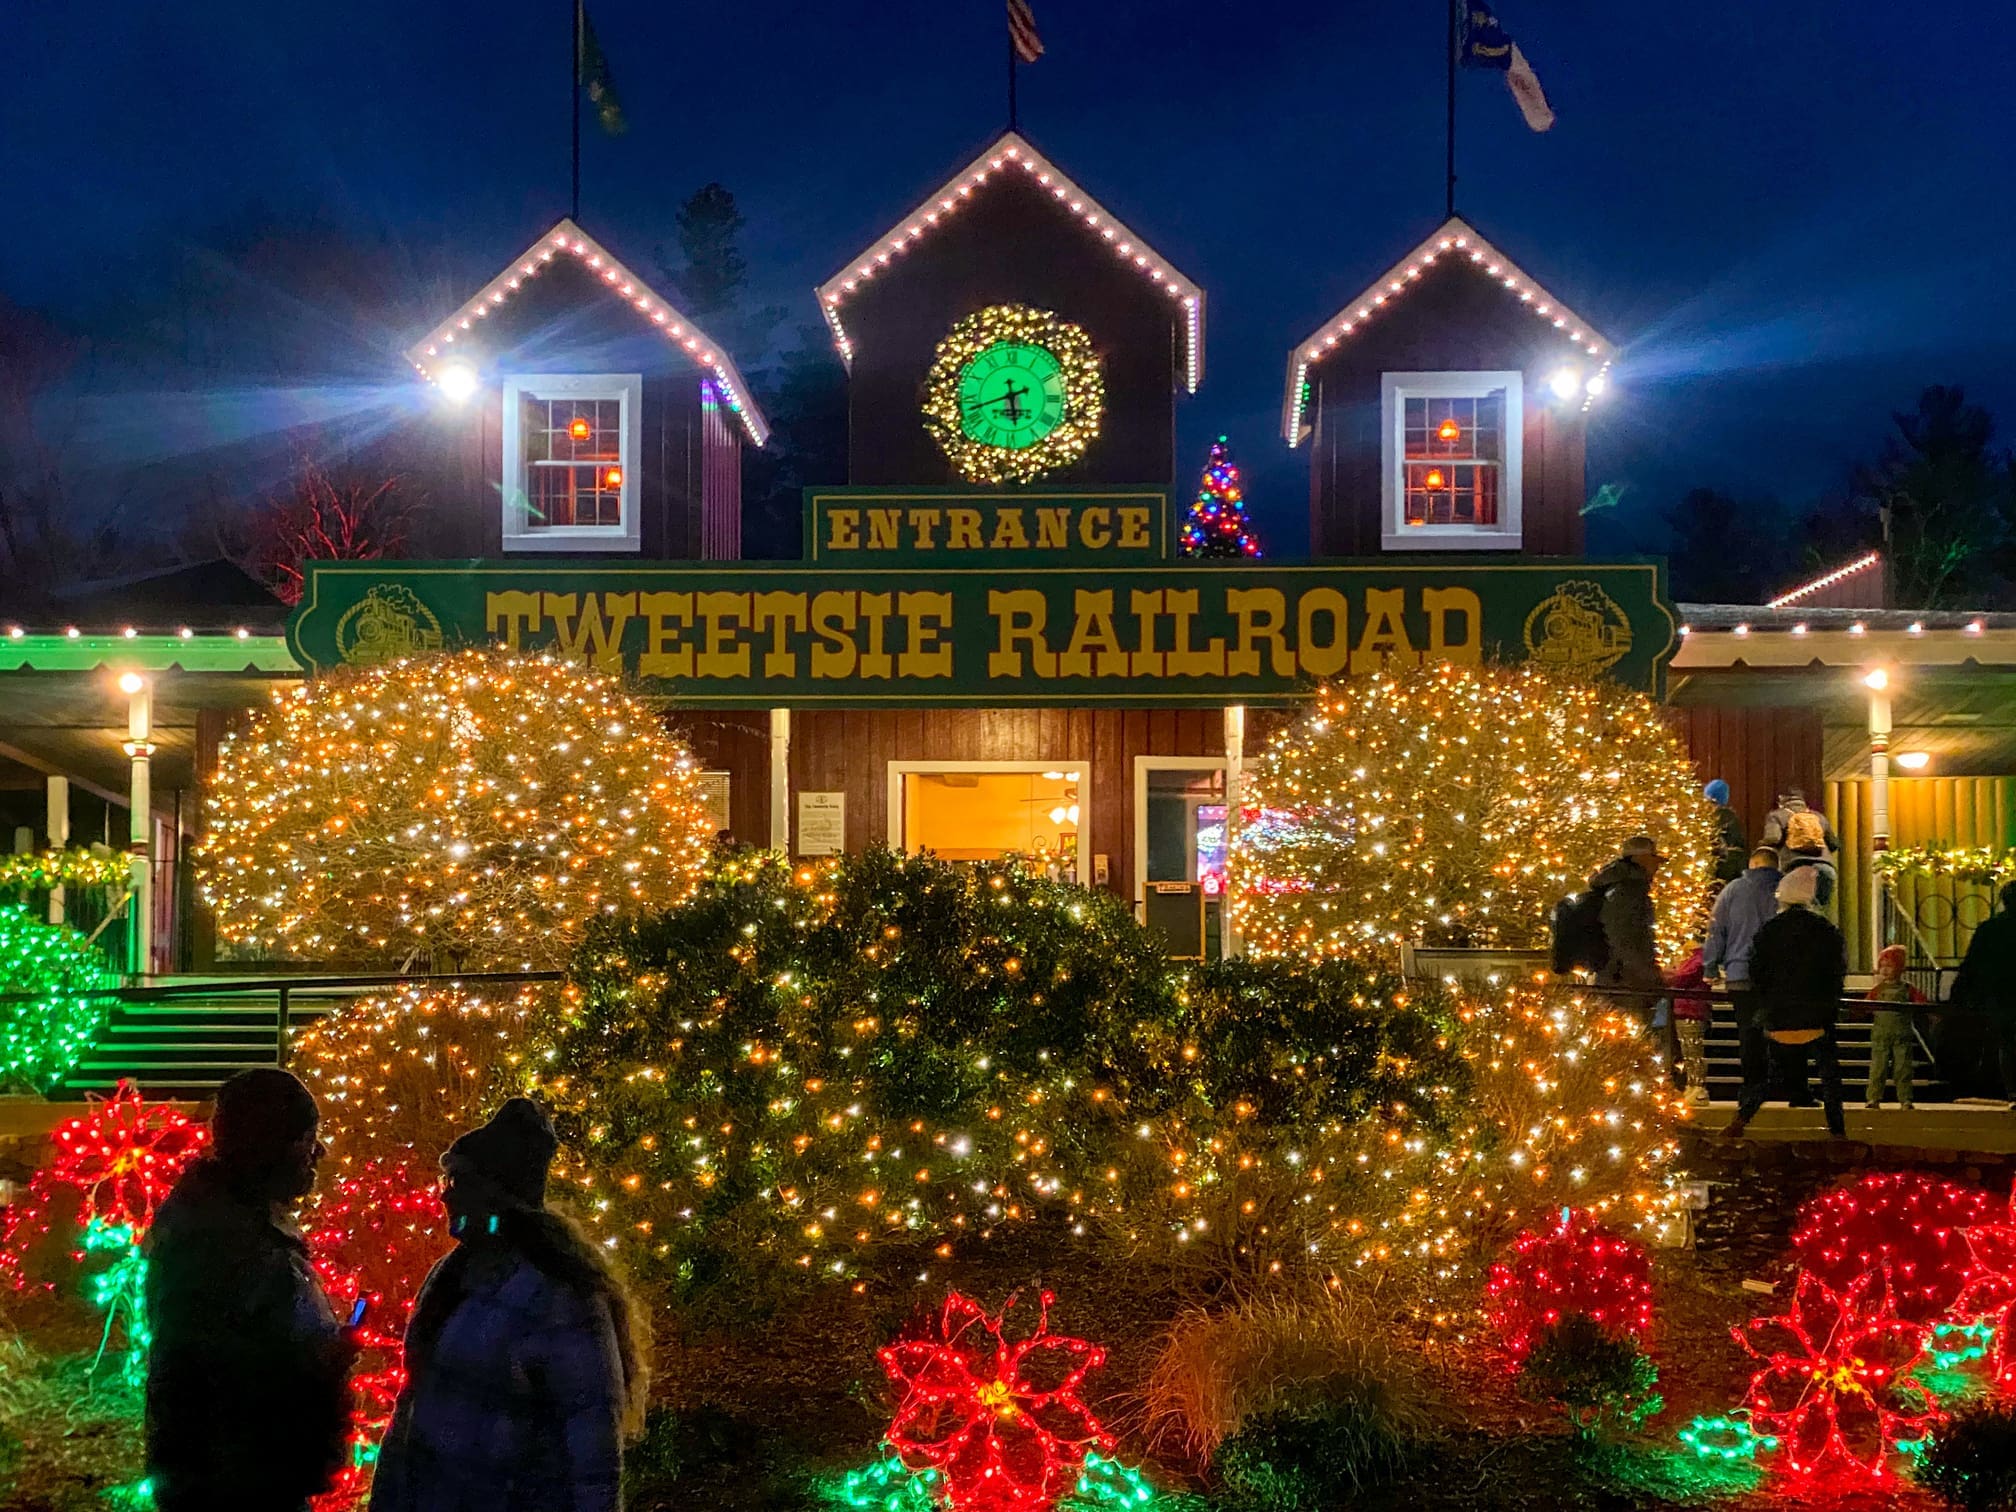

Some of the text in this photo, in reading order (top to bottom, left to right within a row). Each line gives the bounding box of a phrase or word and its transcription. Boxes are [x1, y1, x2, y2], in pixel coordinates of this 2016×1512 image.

[827, 507, 1150, 549] ENTRANCE
[486, 586, 1481, 679] TWEETSIE RAILROAD
